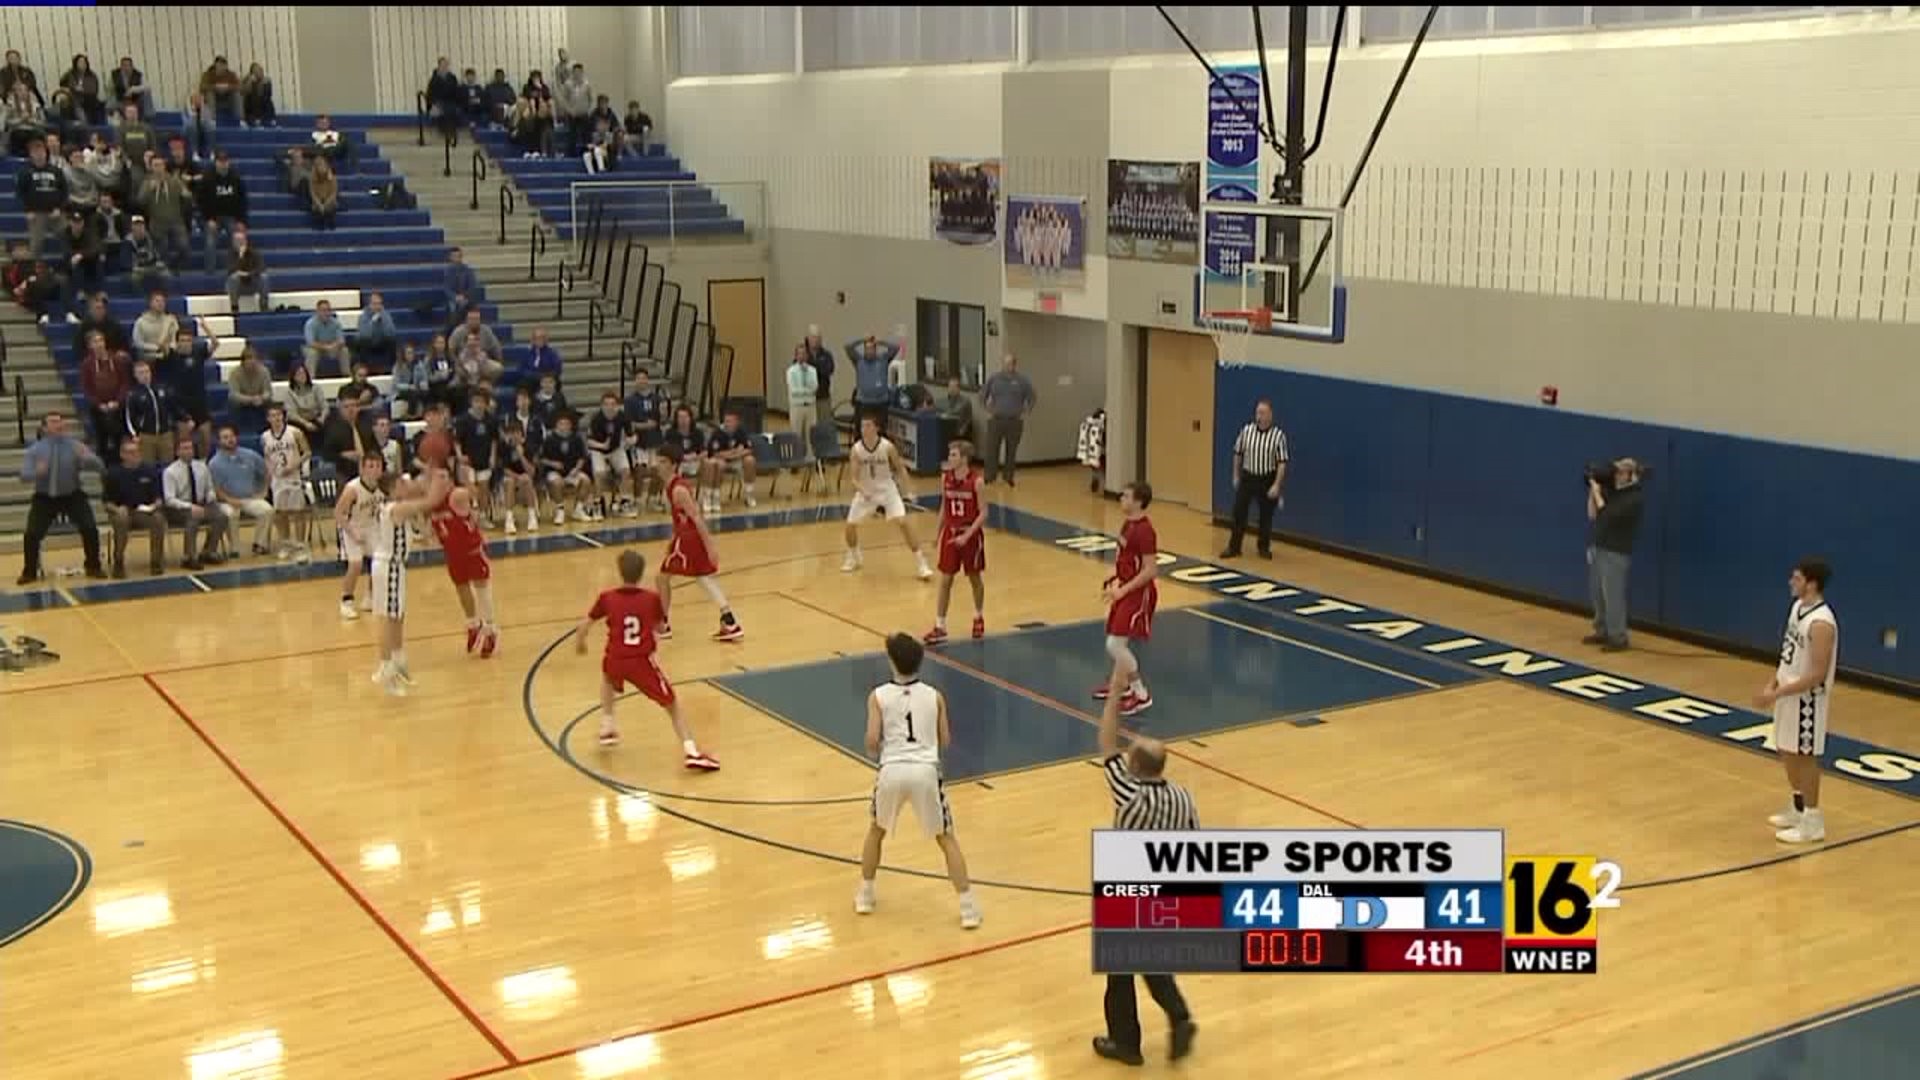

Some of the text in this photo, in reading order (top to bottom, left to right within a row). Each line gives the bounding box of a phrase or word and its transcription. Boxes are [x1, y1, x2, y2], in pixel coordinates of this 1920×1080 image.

[1222, 138, 1244, 152] 2013
[950, 499, 965, 517] 13
[623, 615, 641, 646] 2
[905, 710, 917, 743] 1
